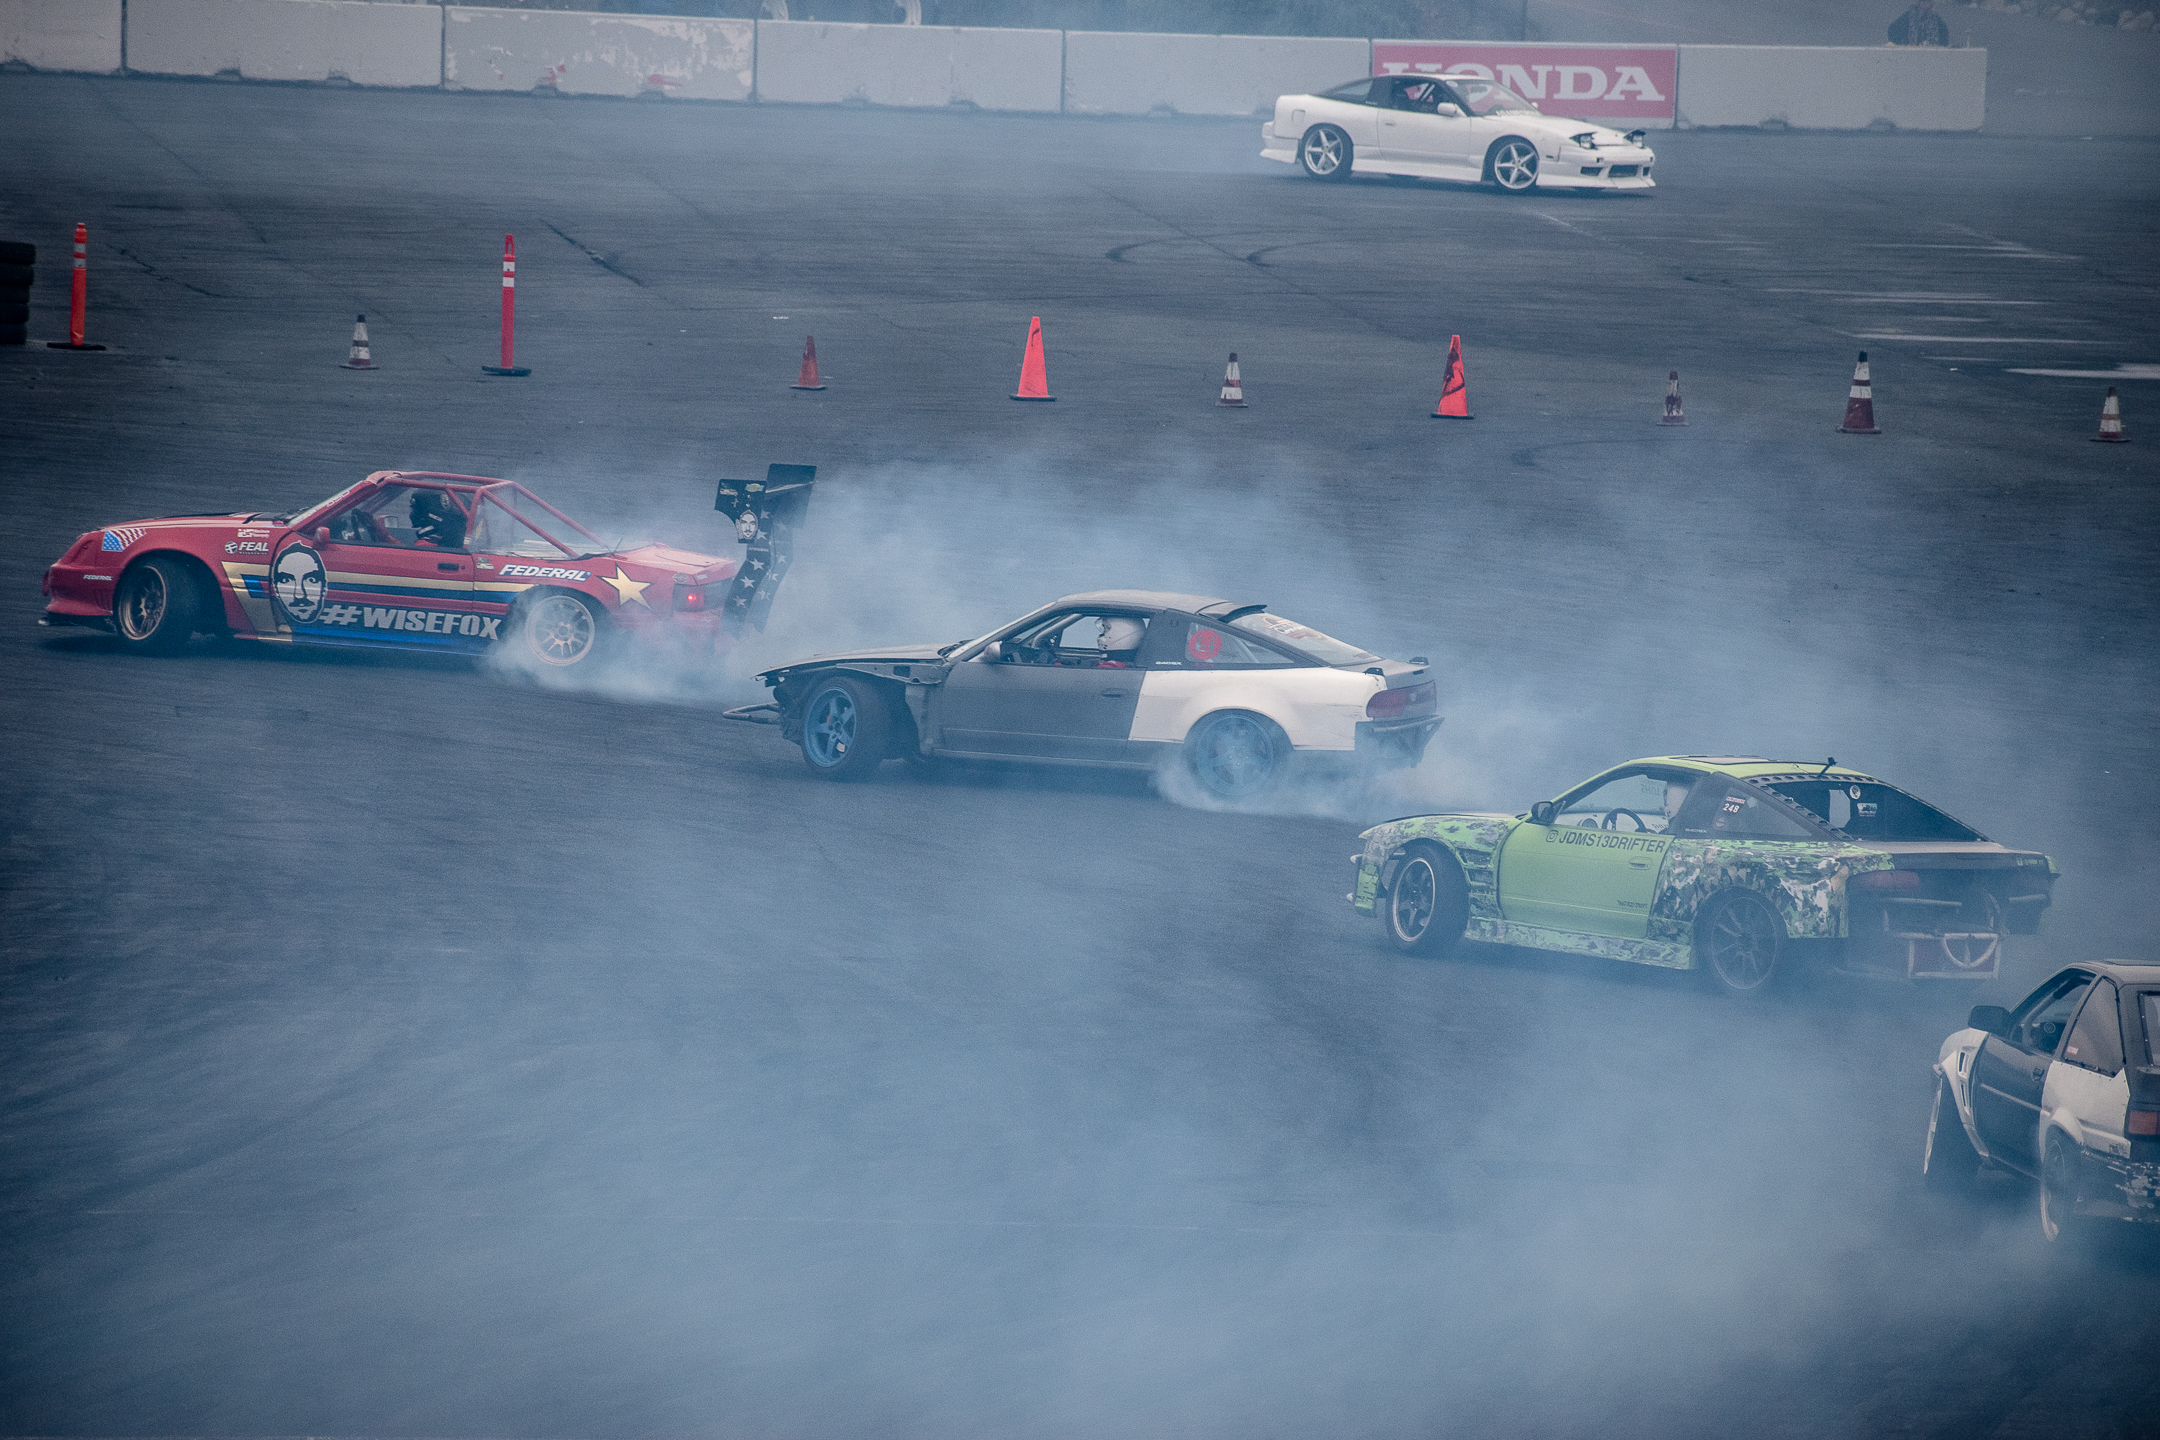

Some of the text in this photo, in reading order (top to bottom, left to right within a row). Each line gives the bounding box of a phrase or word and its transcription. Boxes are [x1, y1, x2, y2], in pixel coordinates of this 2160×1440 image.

[238, 541, 269, 552] FEAL
[498, 564, 588, 582] FEDERAL
[319, 604, 502, 641] #WISEFOX
[1722, 803, 1740, 813] 248
[1559, 831, 1666, 854] JDMS13DRIFTER
